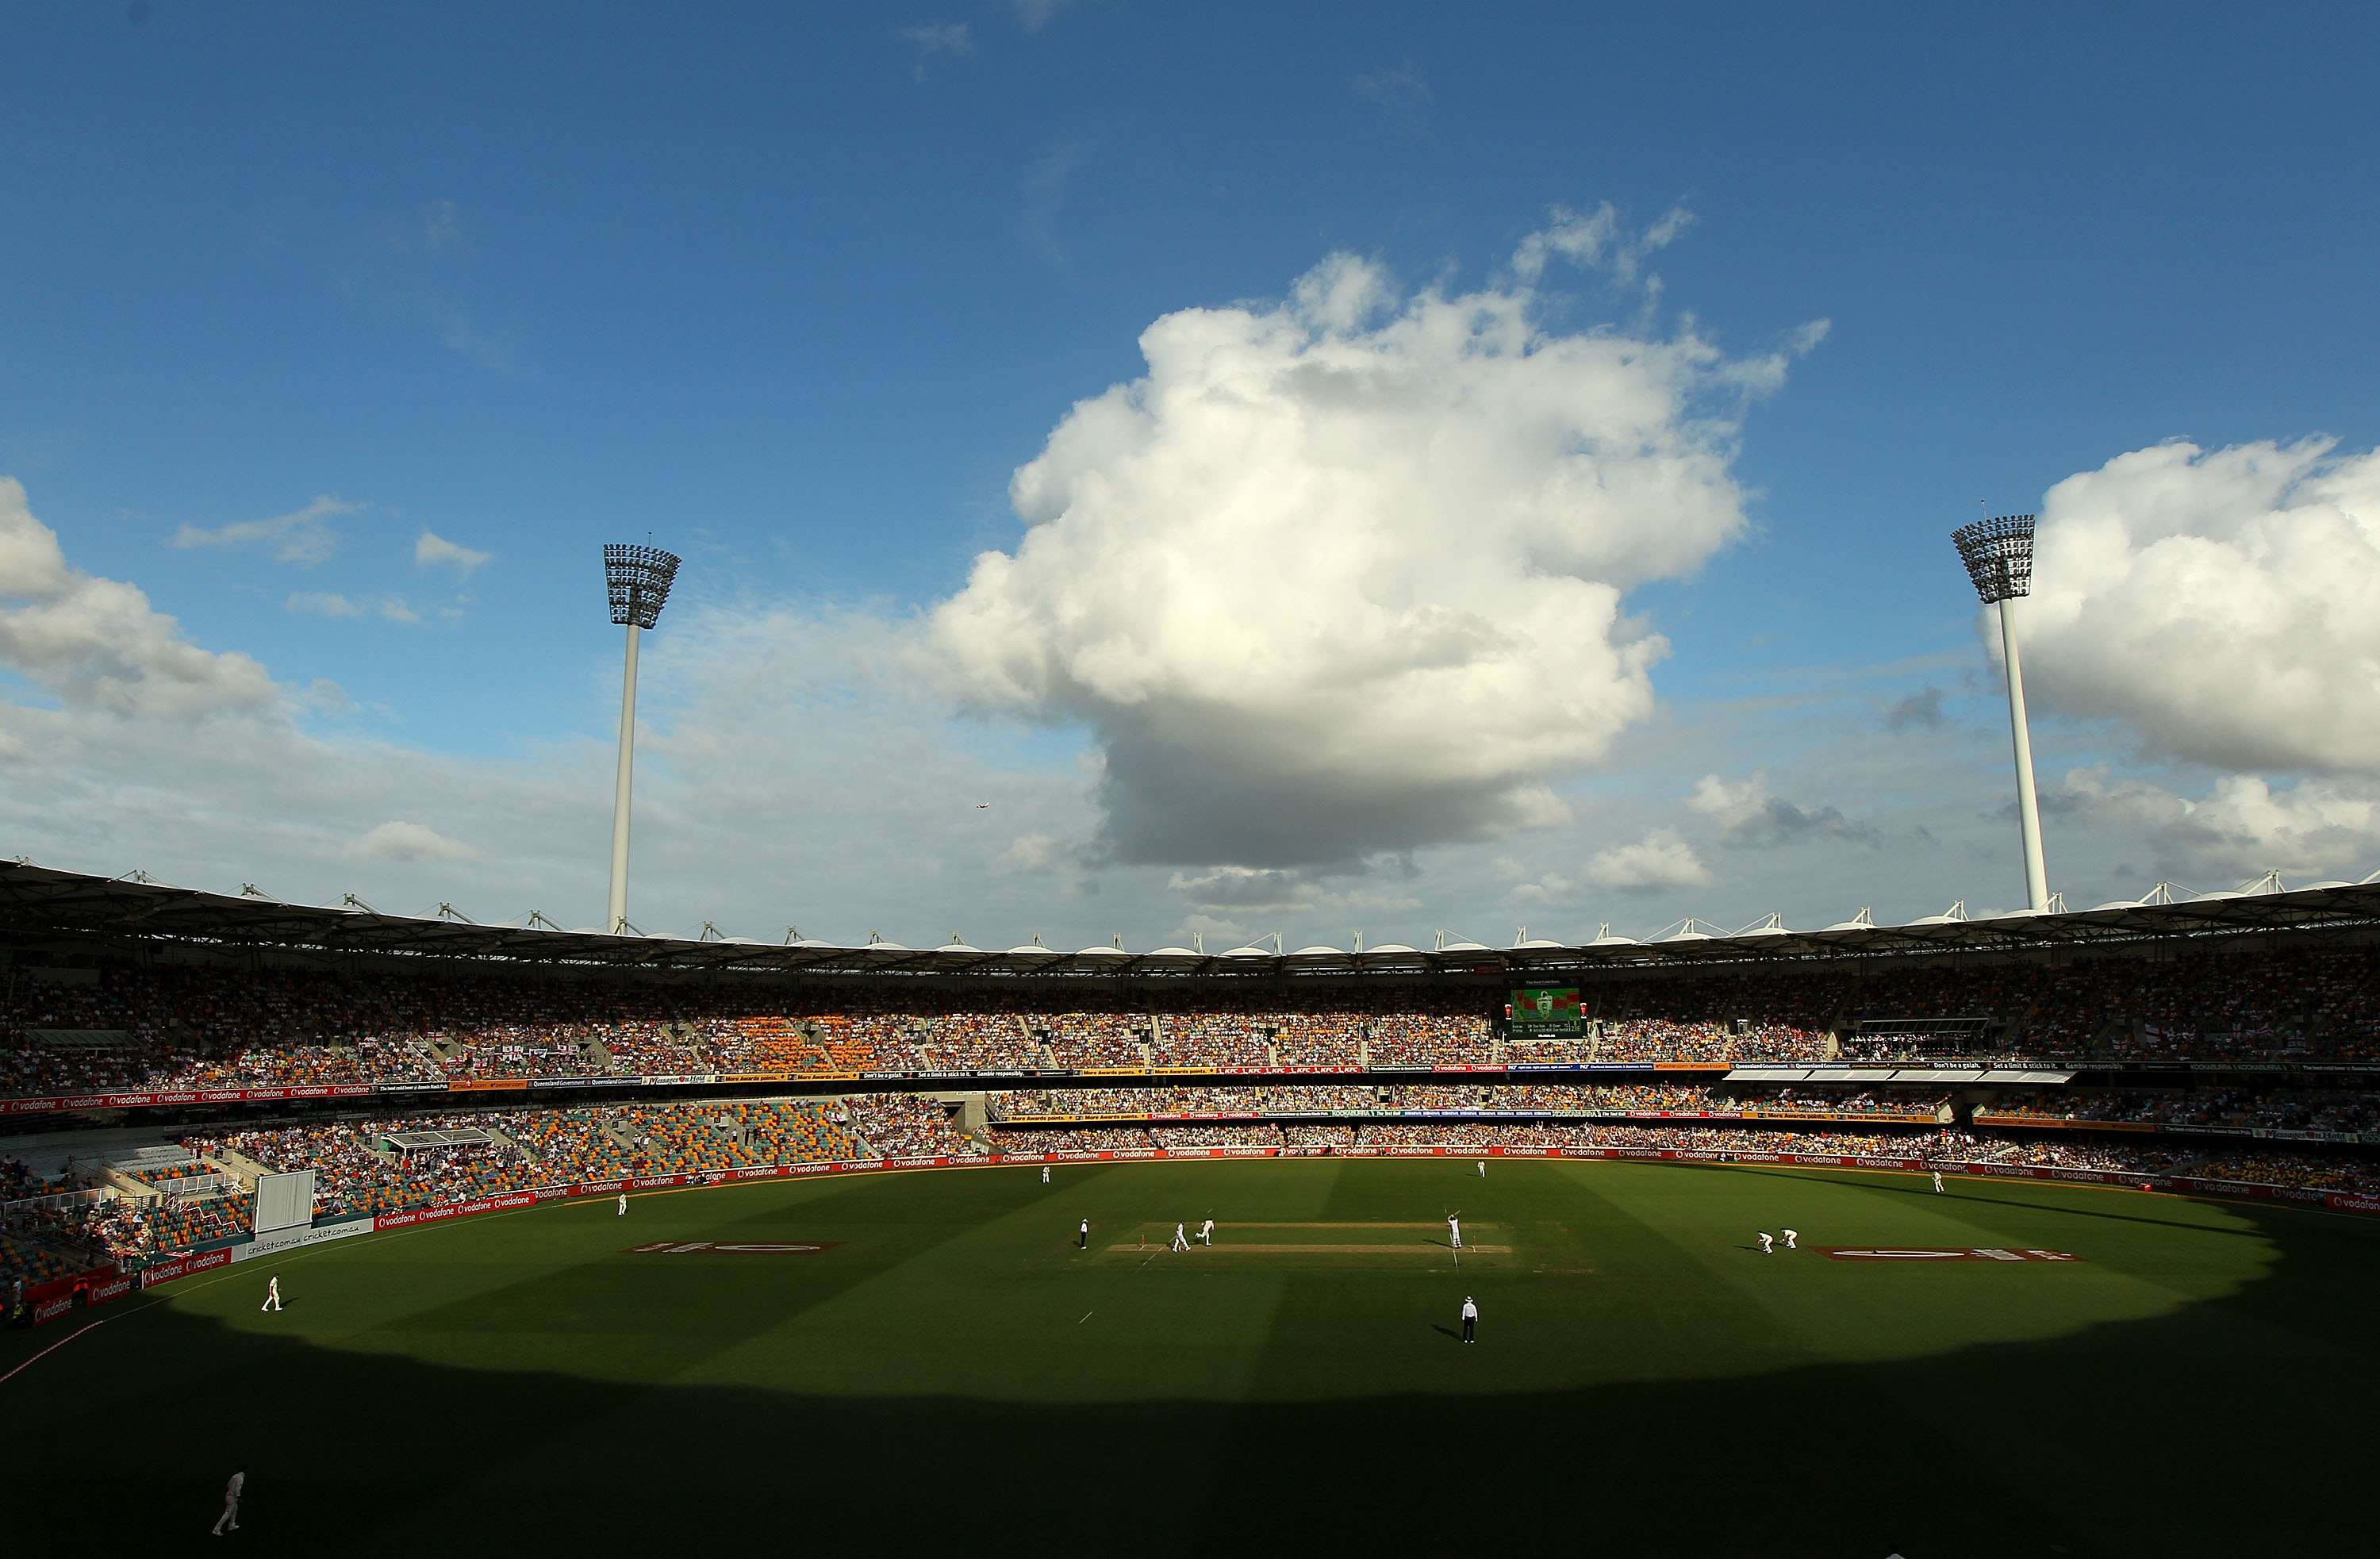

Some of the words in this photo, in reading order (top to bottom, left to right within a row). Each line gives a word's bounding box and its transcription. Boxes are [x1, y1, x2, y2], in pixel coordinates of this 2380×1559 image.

[19, 1100, 56, 1110] vodafone
[69, 1097, 103, 1108] vodafone
[117, 1095, 151, 1105] vodafone
[163, 1092, 196, 1103] vodafone
[208, 1091, 240, 1100] vodafone
[252, 1089, 284, 1098] vodafone
[296, 1087, 328, 1096] vodafone
[340, 1085, 369, 1095] vodafone
[2265, 1129, 2305, 1139] Messages
[2323, 1131, 2345, 1140] Hold
[589, 1181, 622, 1192] vodafone
[640, 1176, 674, 1187] vodafone
[745, 1167, 777, 1177] vodafone
[797, 1163, 830, 1173] vodafone
[850, 1161, 883, 1170] vodafone
[902, 1158, 935, 1167] vodafone
[955, 1155, 989, 1165] vodafone
[1011, 1153, 1044, 1162] vodafone
[1065, 1151, 1099, 1160] vodafone
[1802, 1156, 1841, 1165] vodafone
[1865, 1158, 1903, 1167] vodafone
[1995, 1166, 2034, 1177] vodafone
[2060, 1170, 2103, 1181] vodafone
[2128, 1177, 2172, 1187] vodafone
[2204, 1183, 2250, 1194] vodafone
[2342, 1199, 2380, 1211] vodafon
[386, 1214, 415, 1226] vodafone
[425, 1207, 455, 1219] vodafone
[463, 1201, 491, 1214] vodafone
[500, 1196, 529, 1208] vodafone
[248, 1237, 301, 1255] cricket.com.au
[303, 1225, 359, 1242] cricket.com.au
[152, 1265, 182, 1281] vodafone
[193, 1254, 225, 1269] vodafone
[99, 1279, 130, 1297] vodafone
[42, 1298, 72, 1319] vodafone
